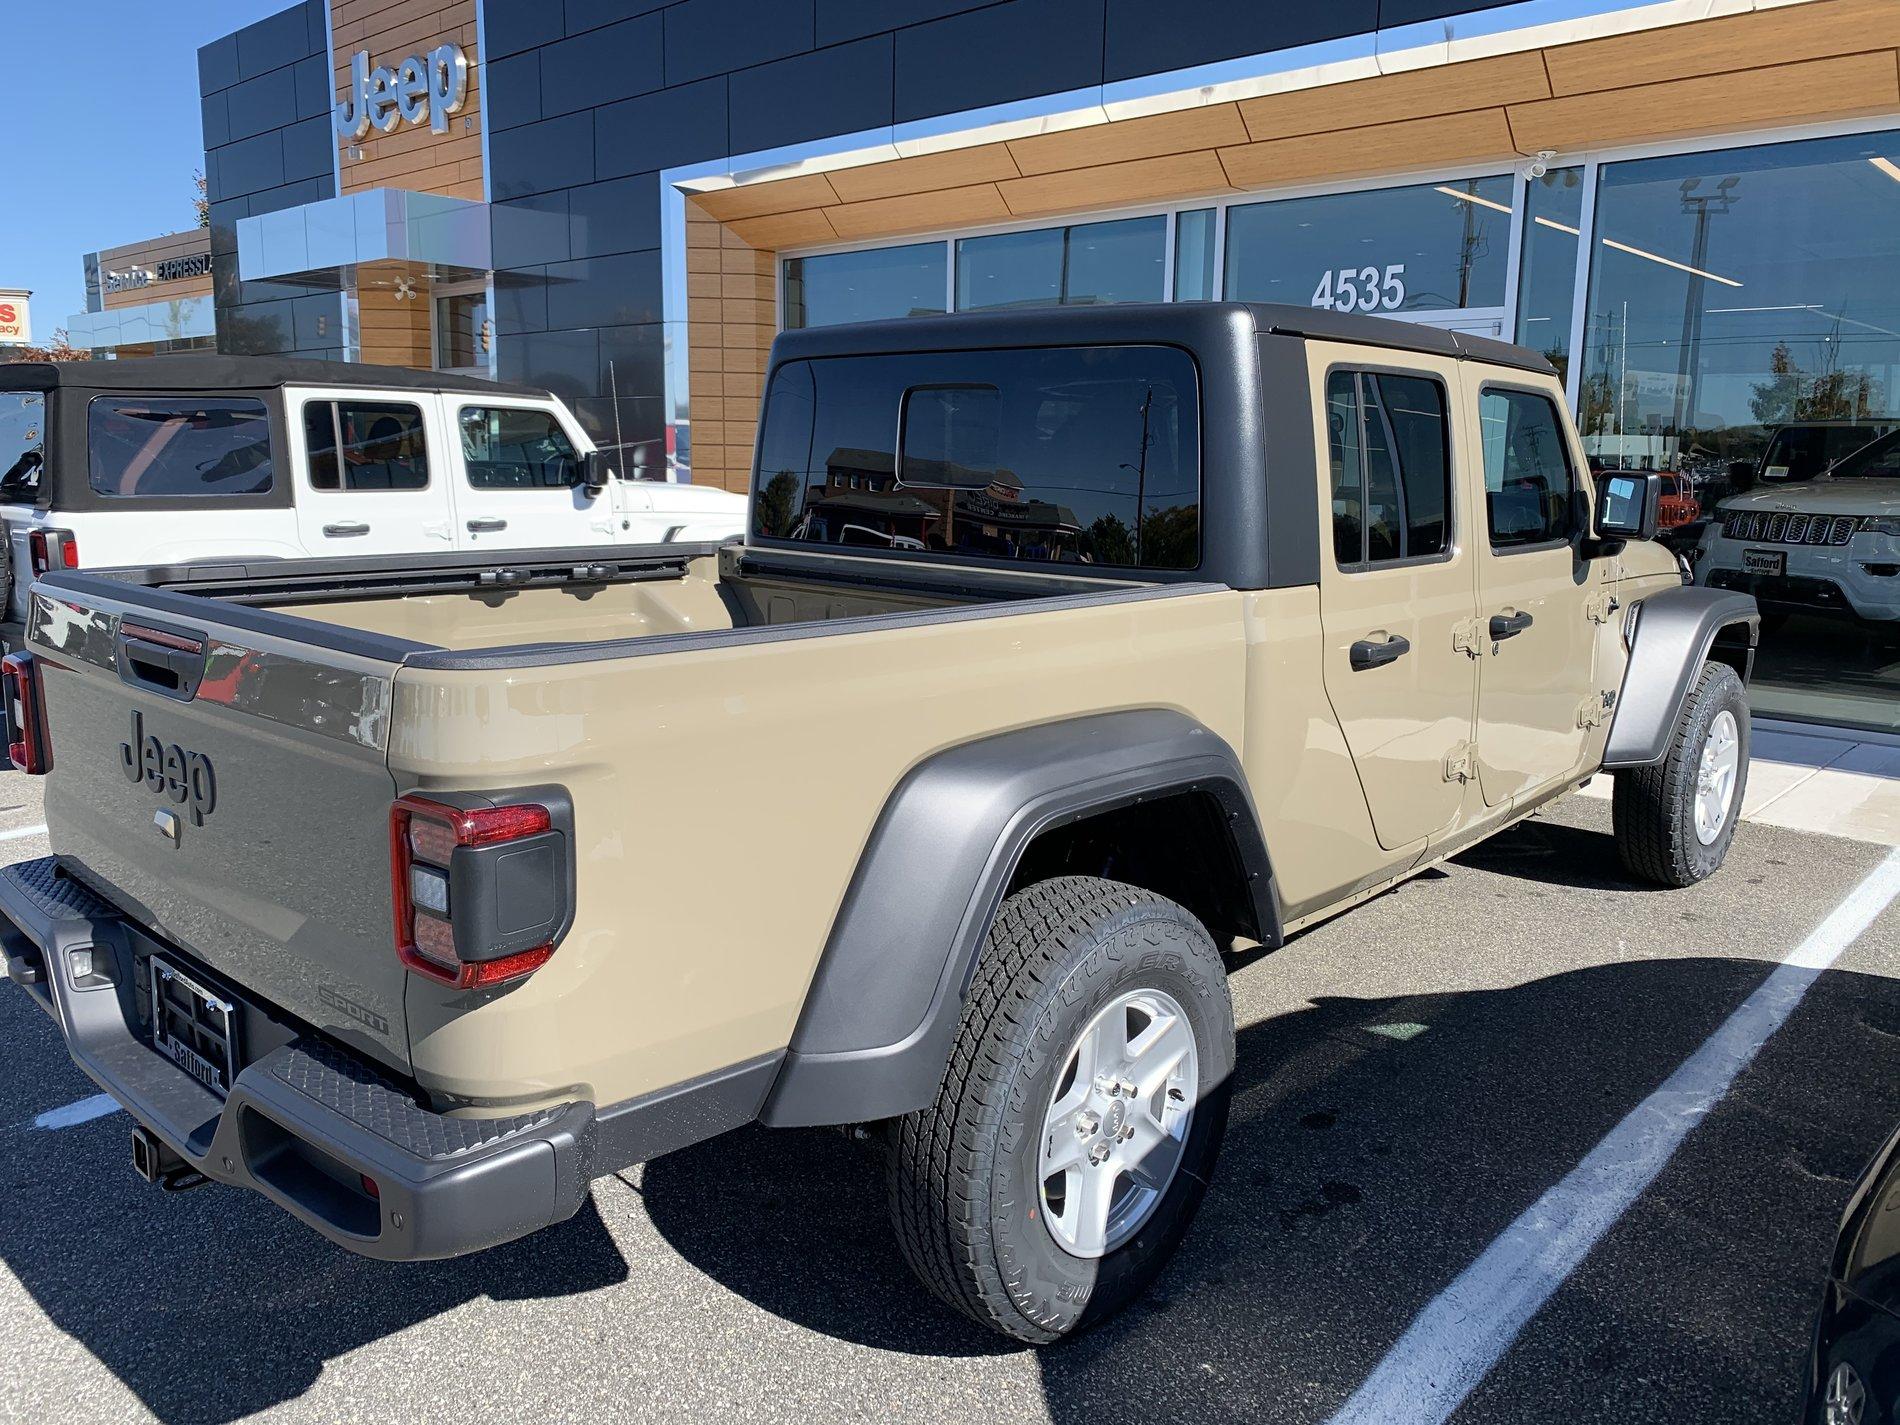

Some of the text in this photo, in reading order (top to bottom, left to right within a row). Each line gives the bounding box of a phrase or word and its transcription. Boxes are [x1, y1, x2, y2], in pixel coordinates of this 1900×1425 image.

[333, 41, 468, 142] Jeep
[105, 253, 212, 293] Service EXPRESSL
[1311, 264, 1405, 313] 4535
[1745, 556, 1780, 570] Safford
[119, 709, 217, 827] Jeep
[318, 985, 389, 1035] SPORT
[174, 1040, 213, 1085] Safford
